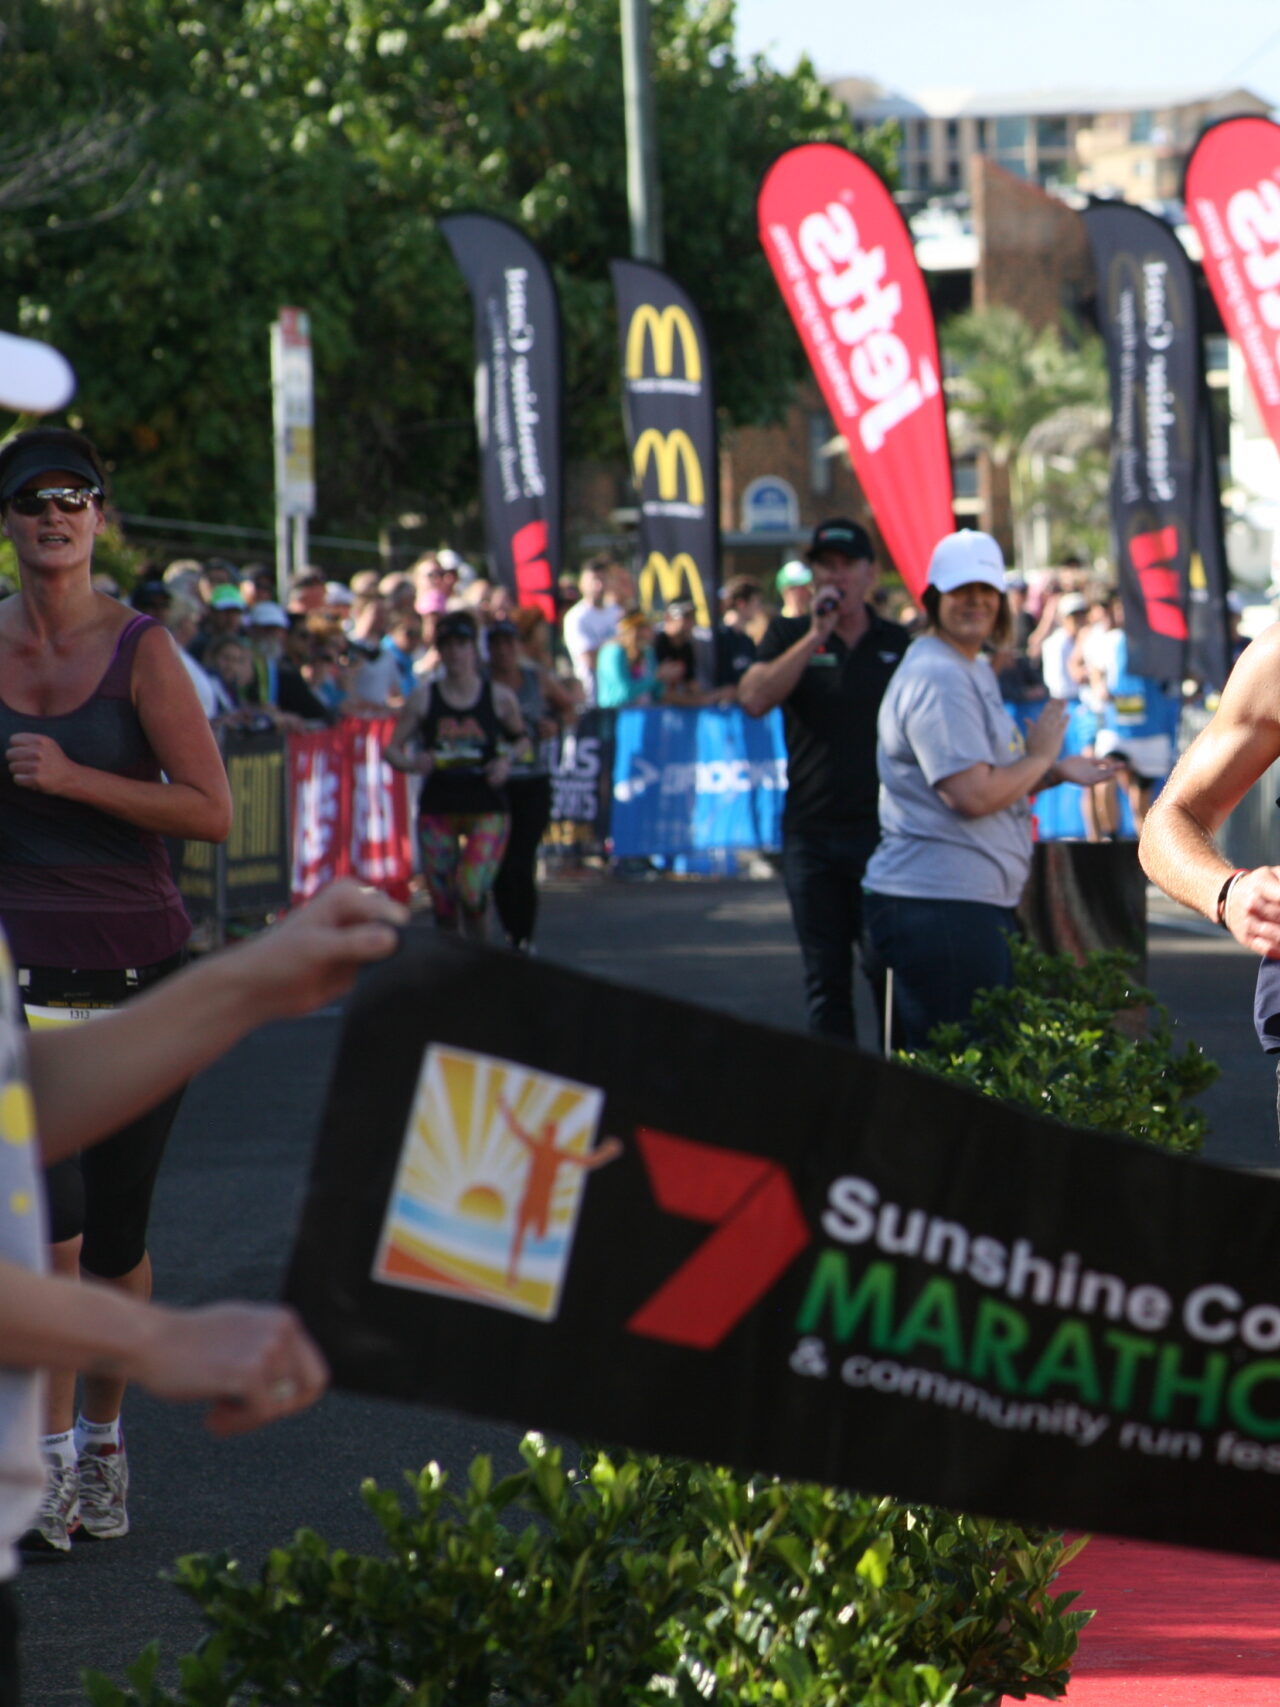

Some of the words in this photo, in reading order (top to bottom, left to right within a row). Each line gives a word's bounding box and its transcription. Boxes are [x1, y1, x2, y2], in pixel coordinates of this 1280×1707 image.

[822, 1174, 1172, 1331] Sunshine
[788, 1337, 829, 1380] &
[840, 1350, 1111, 1449] community
[1118, 1421, 1201, 1462] run
